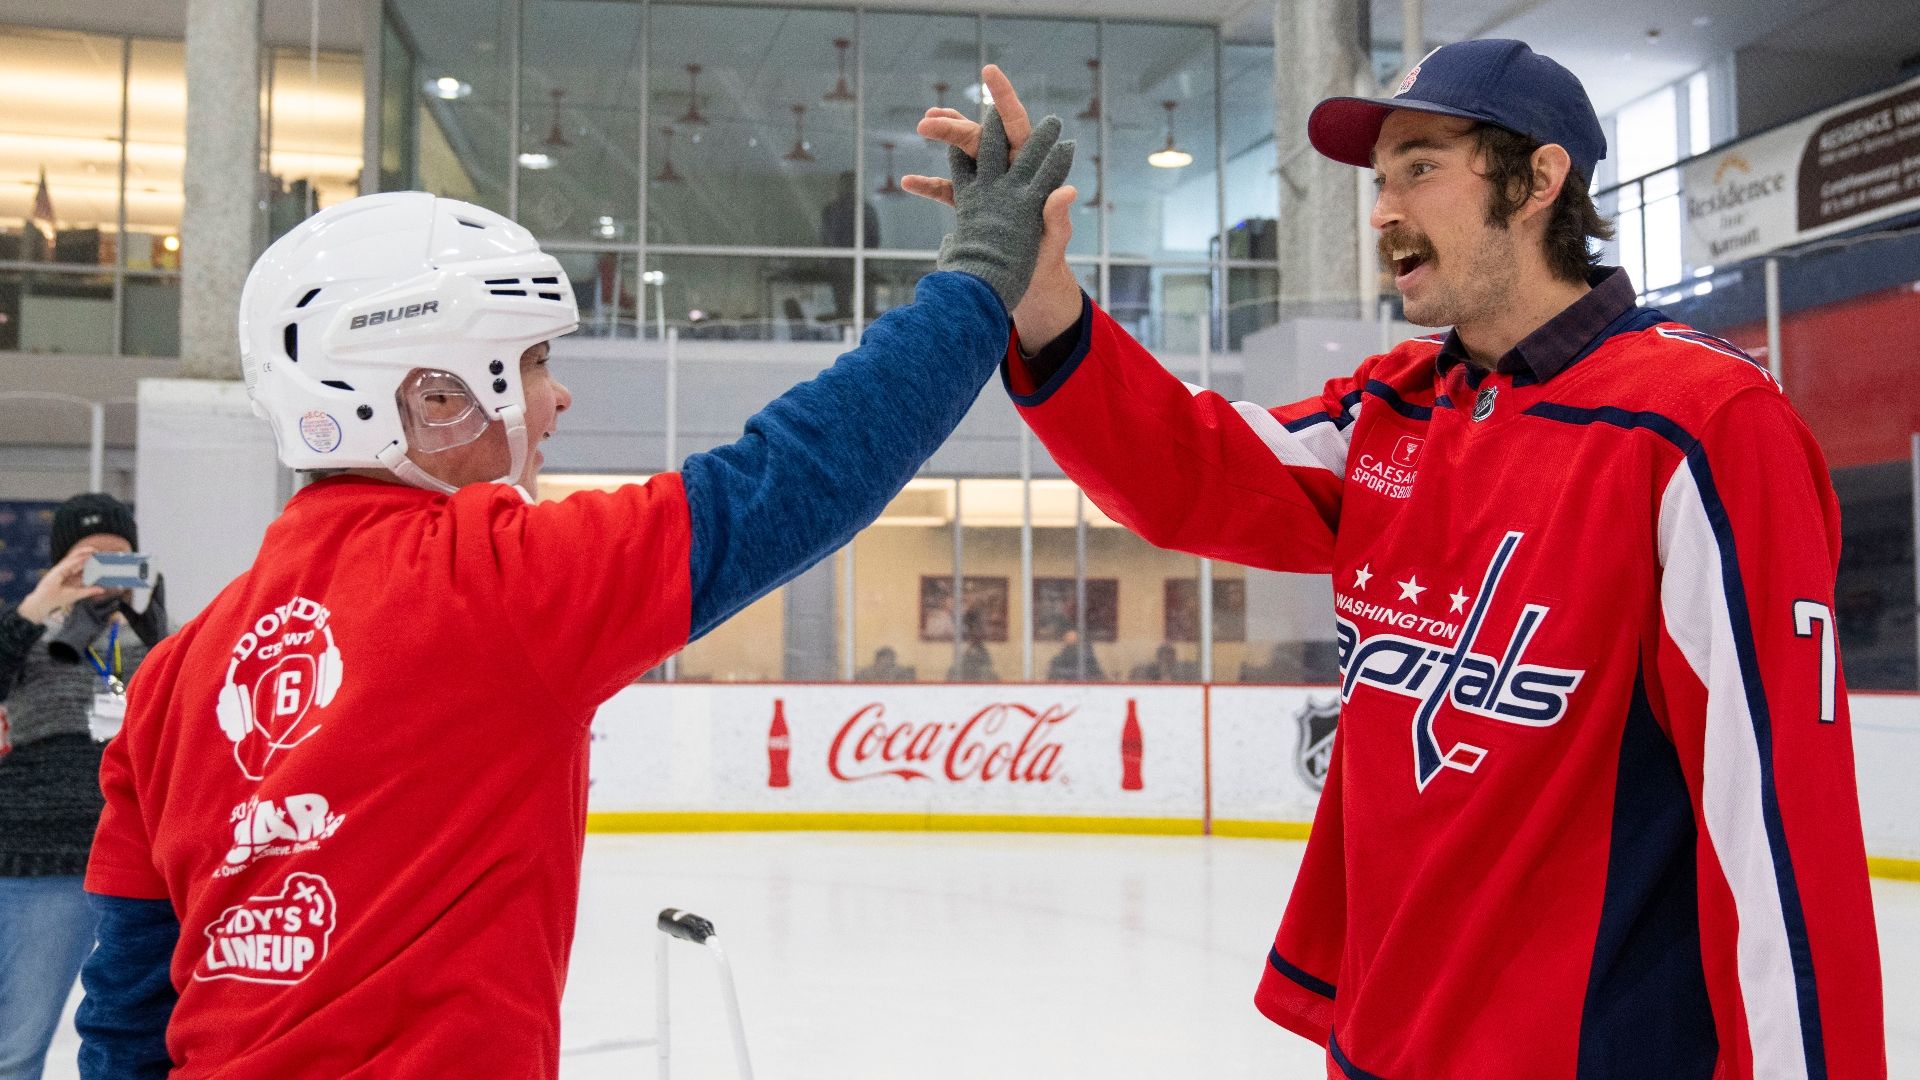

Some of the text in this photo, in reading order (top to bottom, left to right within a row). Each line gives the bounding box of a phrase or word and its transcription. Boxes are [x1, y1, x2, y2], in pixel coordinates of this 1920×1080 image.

[1336, 593, 1459, 640] WASHINGTON
[276, 670, 302, 716] 6
[206, 934, 315, 972] LINEUP
